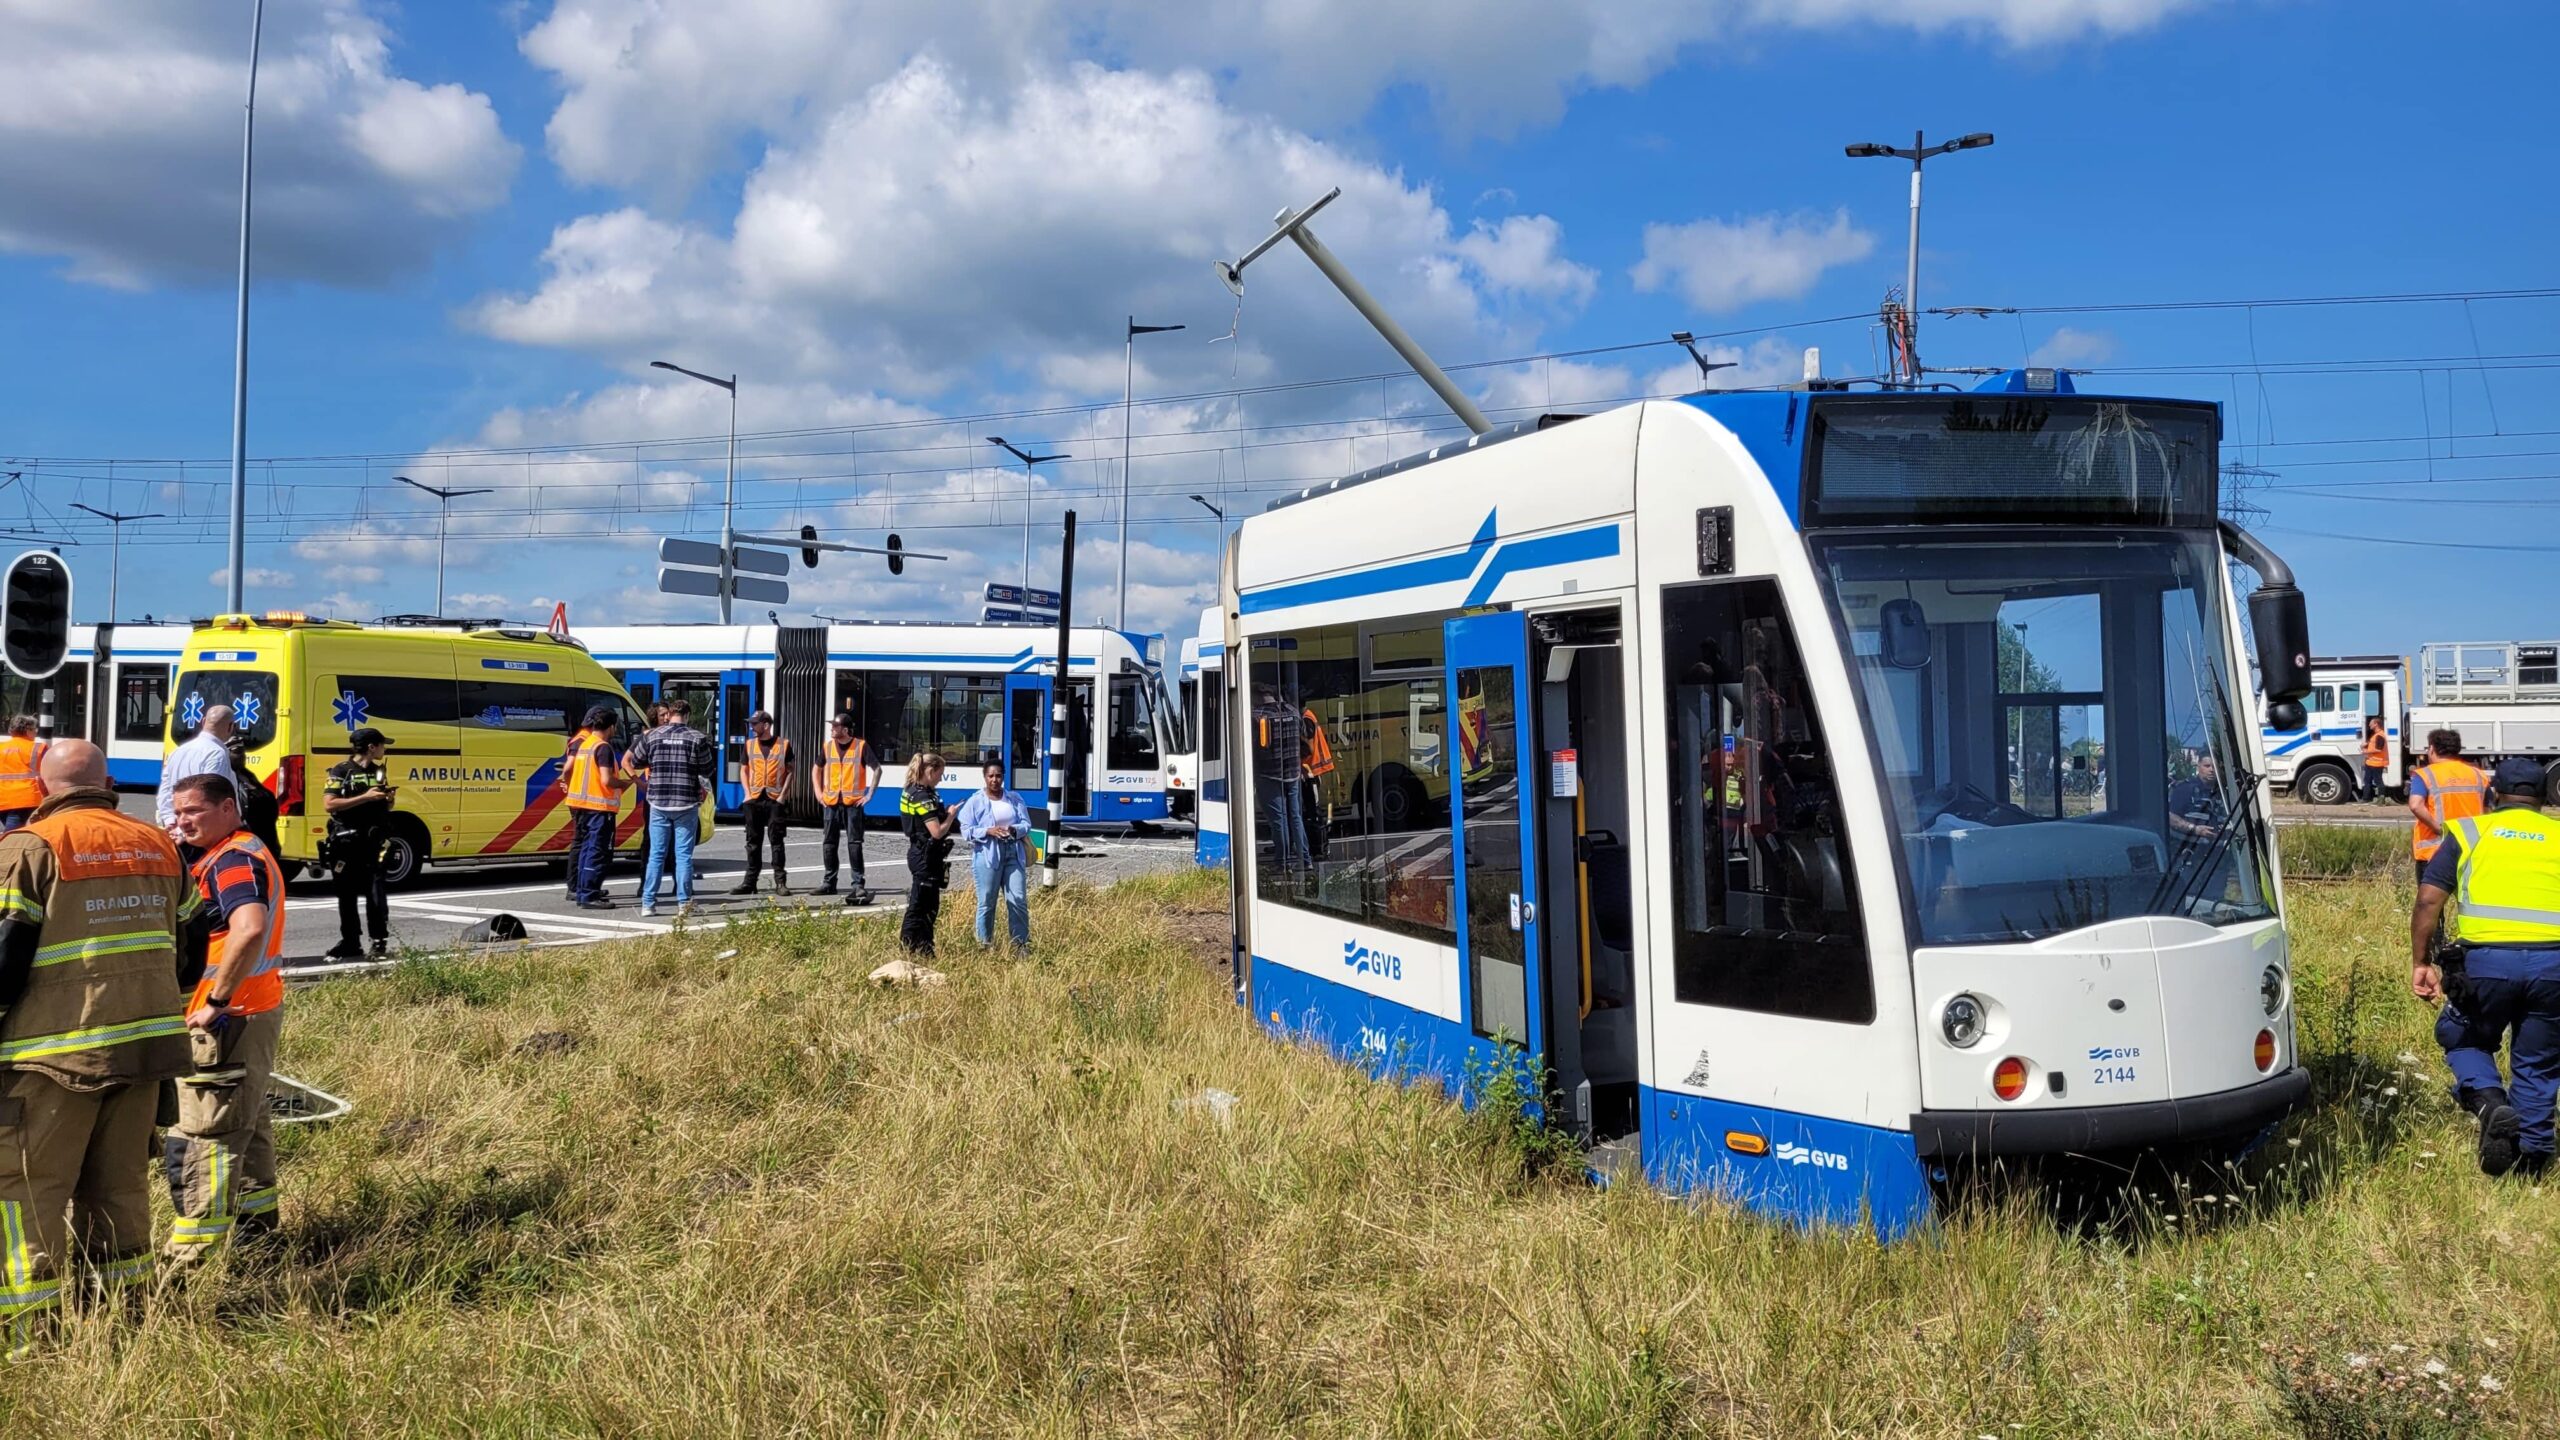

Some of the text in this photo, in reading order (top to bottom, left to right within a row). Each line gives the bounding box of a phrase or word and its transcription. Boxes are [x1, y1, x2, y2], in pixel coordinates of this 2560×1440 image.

[32, 557, 47, 565] 122
[408, 768, 516, 781] AMBULANCE
[1371, 950, 1401, 980] GVB
[1361, 1026, 1387, 1055] 2144
[2114, 1047, 2140, 1058] GVB
[2094, 1066, 2136, 1084] 2144
[1810, 1149, 1849, 1171] GVB
